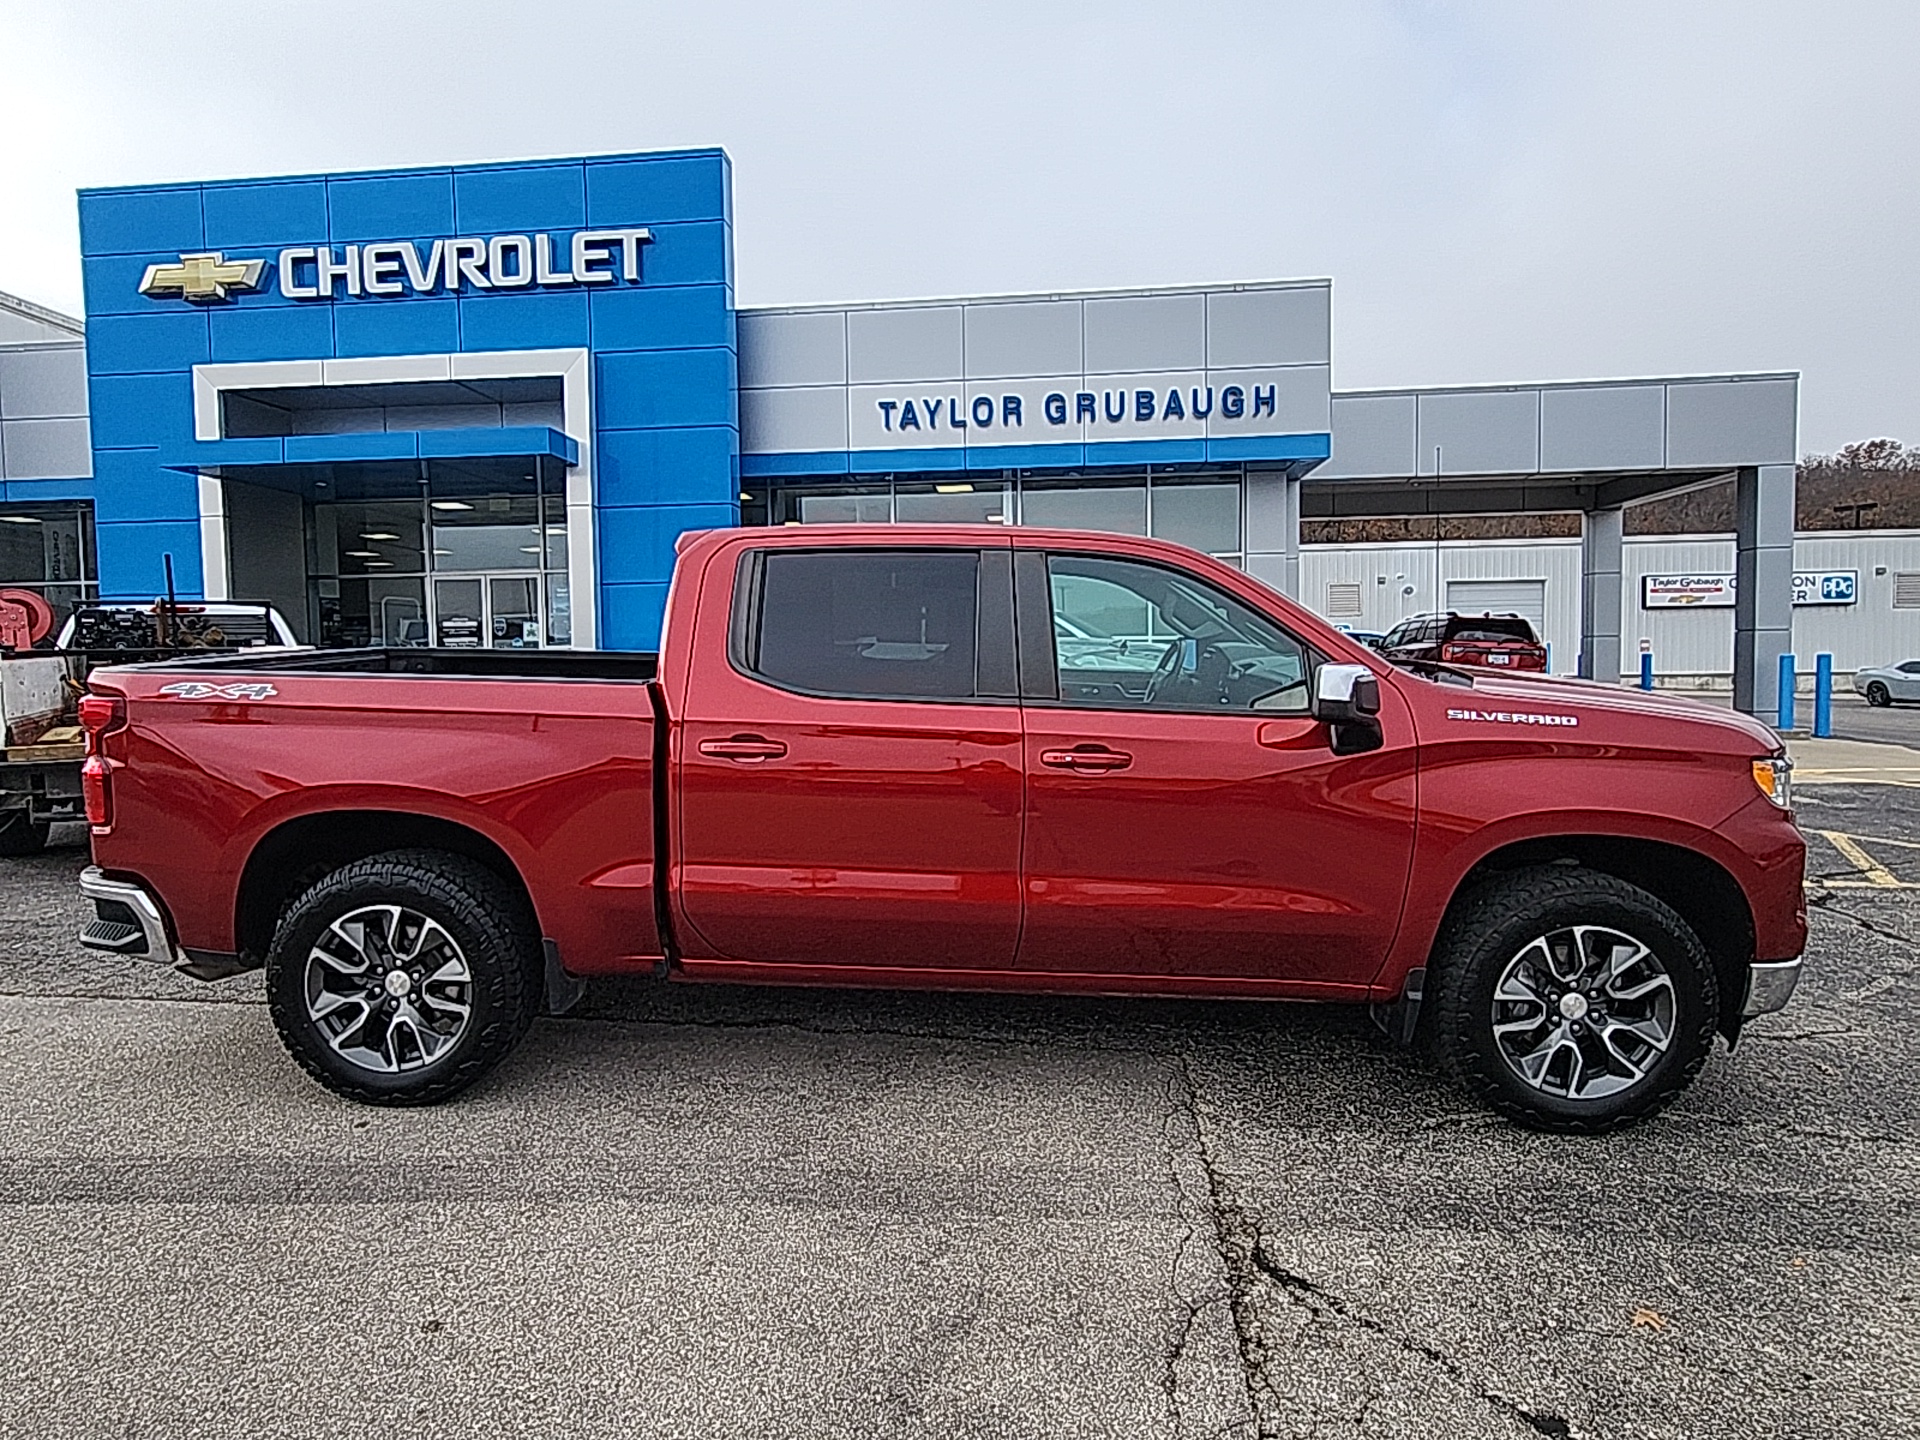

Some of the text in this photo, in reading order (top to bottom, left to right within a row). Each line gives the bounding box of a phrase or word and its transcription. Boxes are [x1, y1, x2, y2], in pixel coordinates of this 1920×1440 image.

[279, 228, 650, 297] CHEVROLET
[878, 385, 1277, 431] TAYLOR GRUBAUGH
[1650, 578, 1679, 587] Taylor
[1822, 578, 1853, 598] PPG
[1447, 709, 1578, 726] SILVERADO
